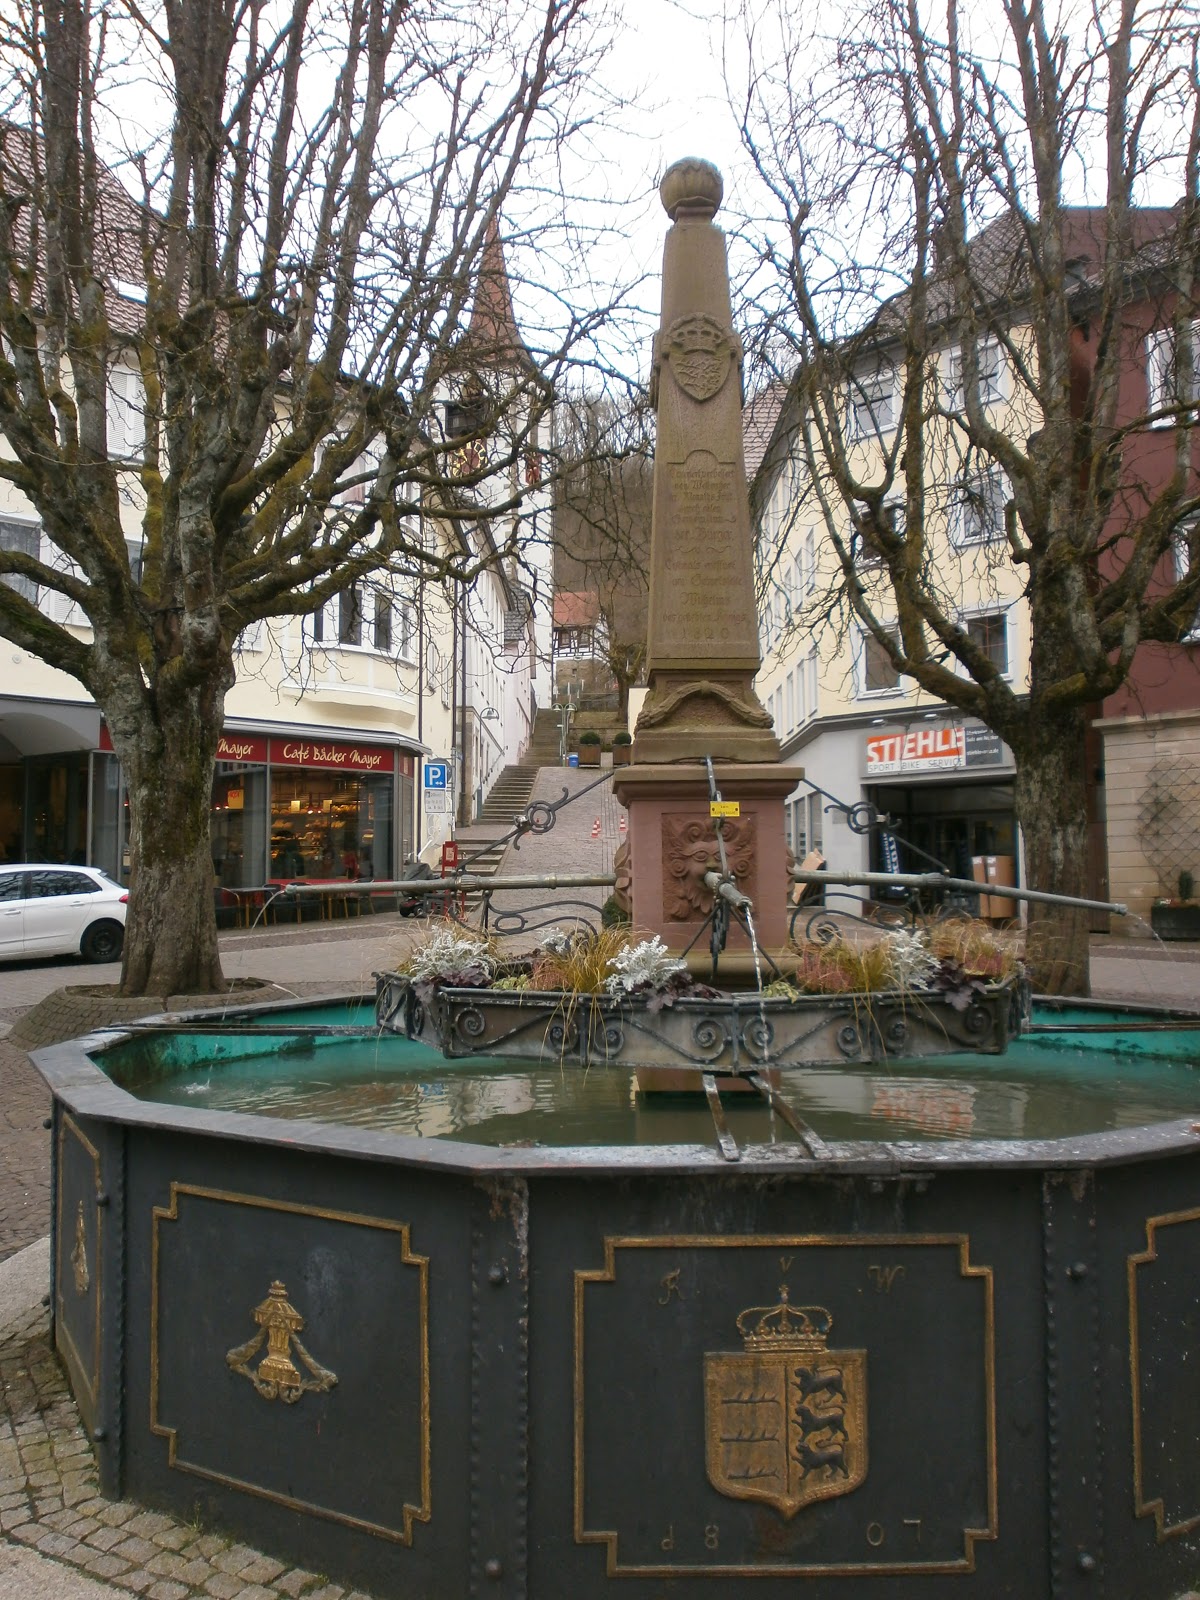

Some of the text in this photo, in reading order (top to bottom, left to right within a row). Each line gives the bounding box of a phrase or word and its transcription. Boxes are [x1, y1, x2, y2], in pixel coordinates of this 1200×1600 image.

[217, 738, 254, 760] Mayer
[283, 743, 310, 763] Café
[313, 746, 347, 763] Bäcker
[350, 750, 382, 769] Mayer
[867, 728, 964, 763] STIEHLE
[429, 766, 441, 786] P
[868, 757, 963, 773] SPORT BIKE SERVICE
